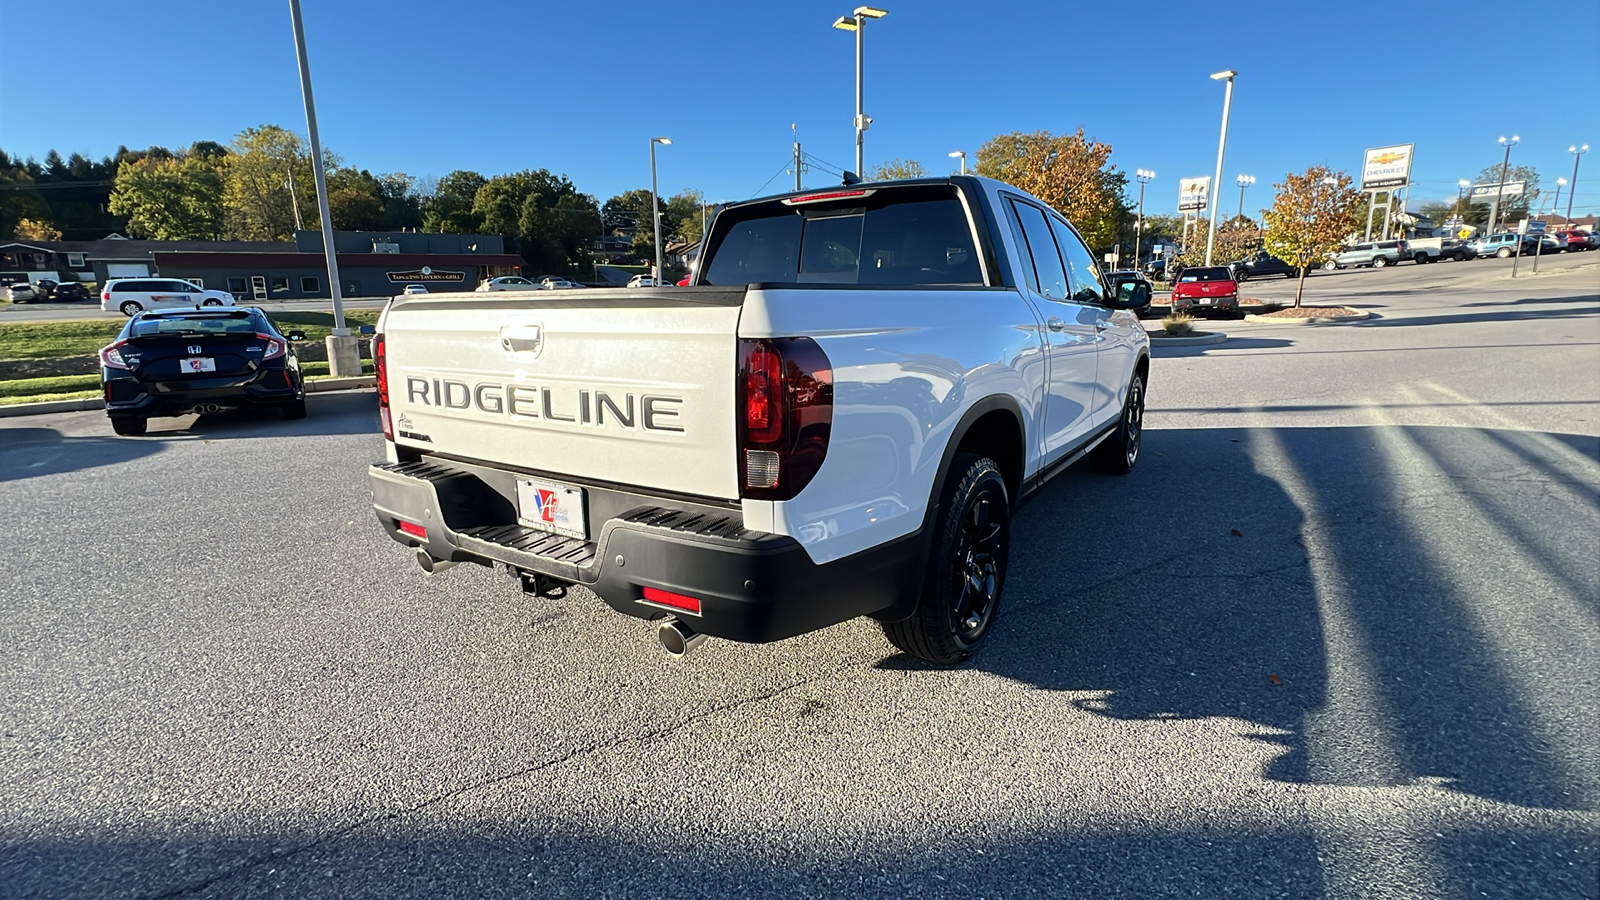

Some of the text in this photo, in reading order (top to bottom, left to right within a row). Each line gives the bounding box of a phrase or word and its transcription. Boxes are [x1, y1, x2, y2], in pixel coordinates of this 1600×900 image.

[1366, 167, 1405, 176] CHEVROLET
[407, 376, 685, 433] RIDGELINE
[556, 527, 586, 540] HONDA
